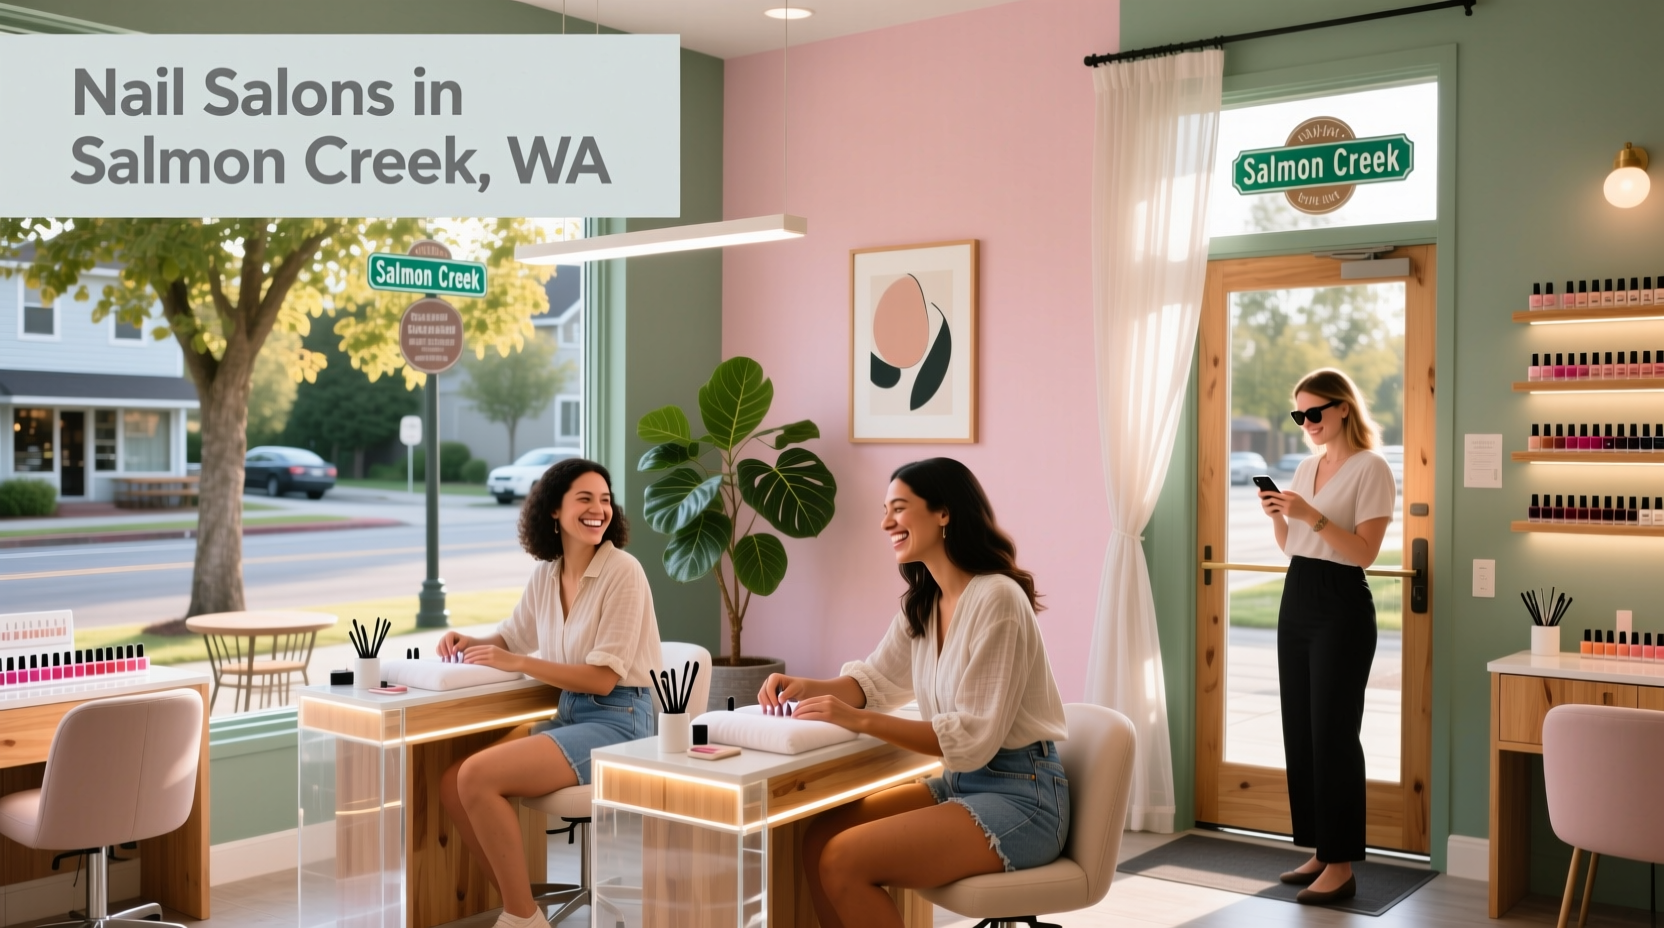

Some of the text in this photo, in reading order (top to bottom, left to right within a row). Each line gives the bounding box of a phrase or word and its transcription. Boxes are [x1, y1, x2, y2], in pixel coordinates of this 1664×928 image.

[1243, 143, 1400, 185] Salmon Creek
[376, 259, 481, 291] Salmon Creek
